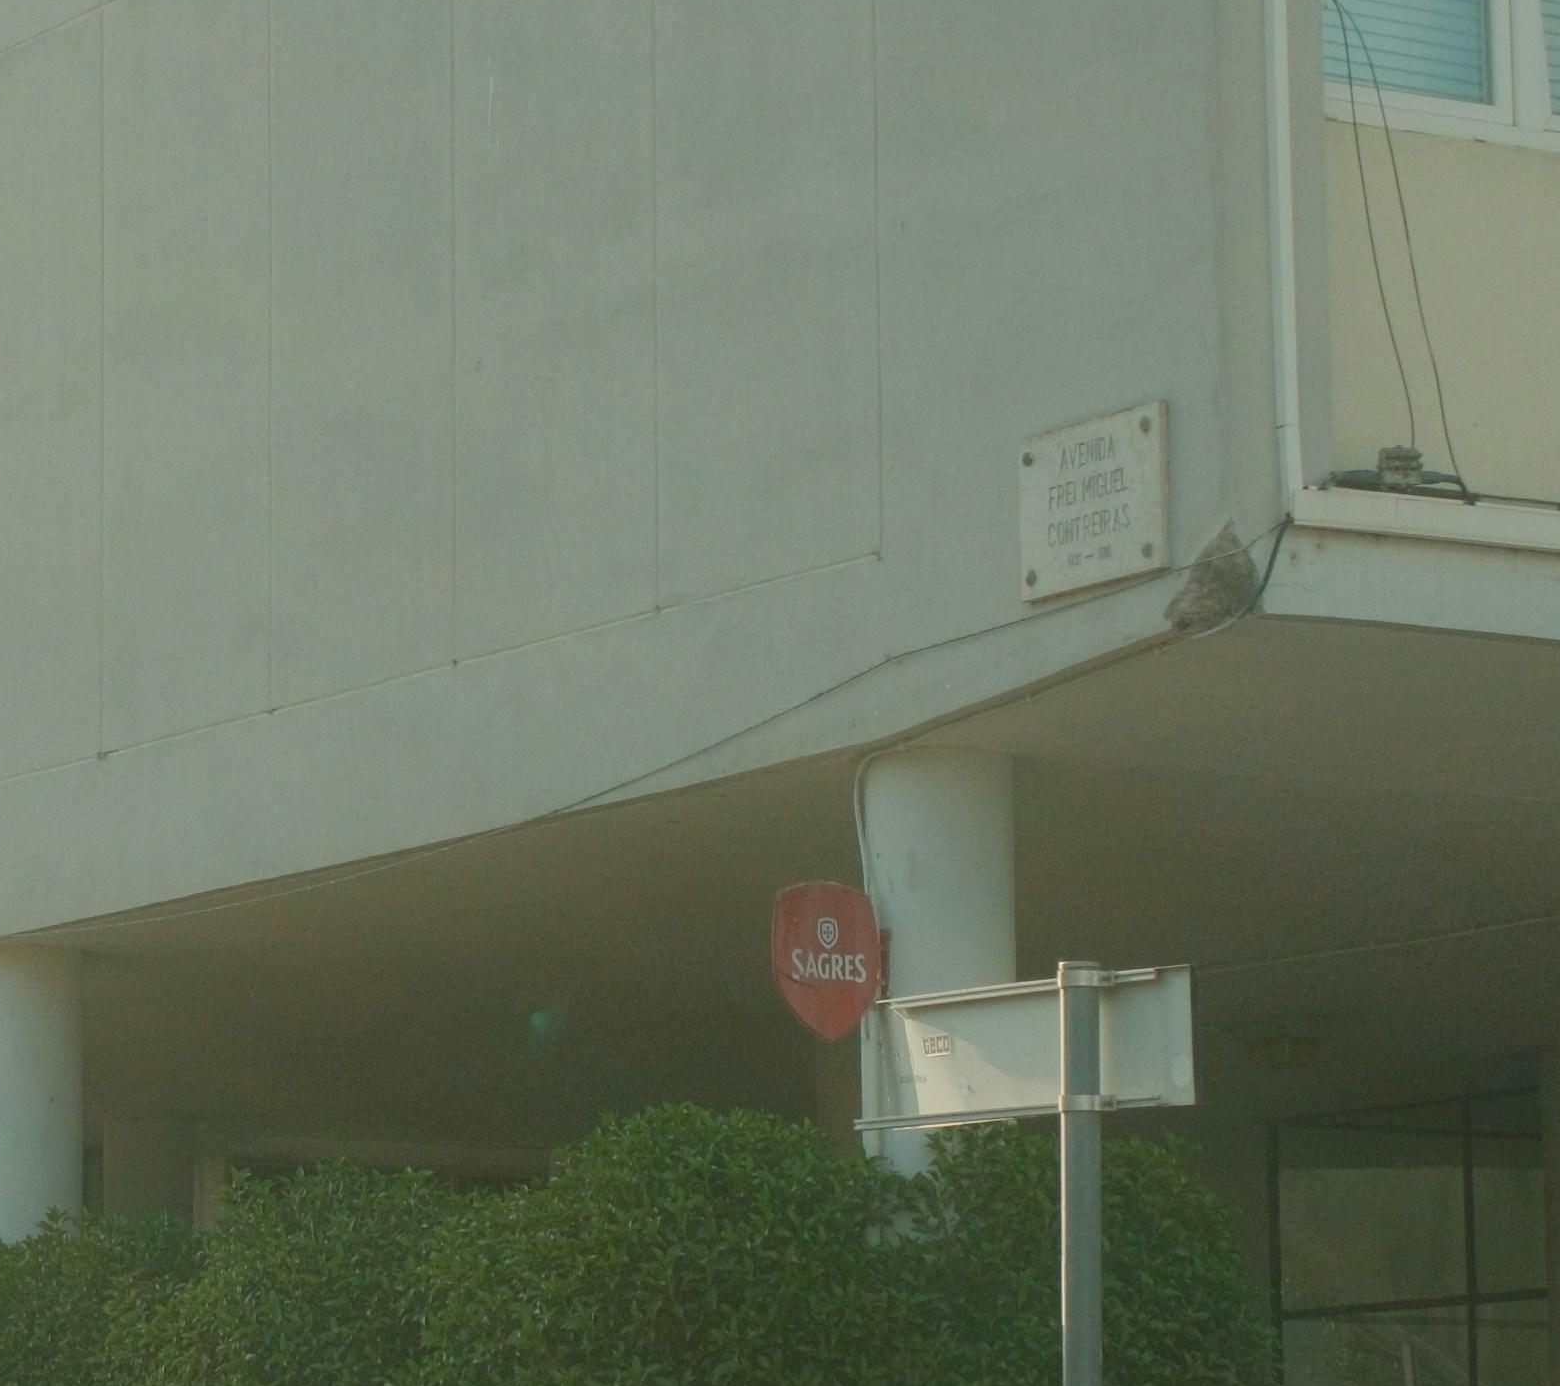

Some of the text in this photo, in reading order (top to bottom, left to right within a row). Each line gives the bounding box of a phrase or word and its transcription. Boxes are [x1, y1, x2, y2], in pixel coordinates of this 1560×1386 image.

[1059, 433, 1116, 472] AVENIDA
[1047, 466, 1129, 512] FREI MIGUEL
[1046, 502, 1132, 548] CONTREIRAS
[790, 948, 867, 984] SAGRES
